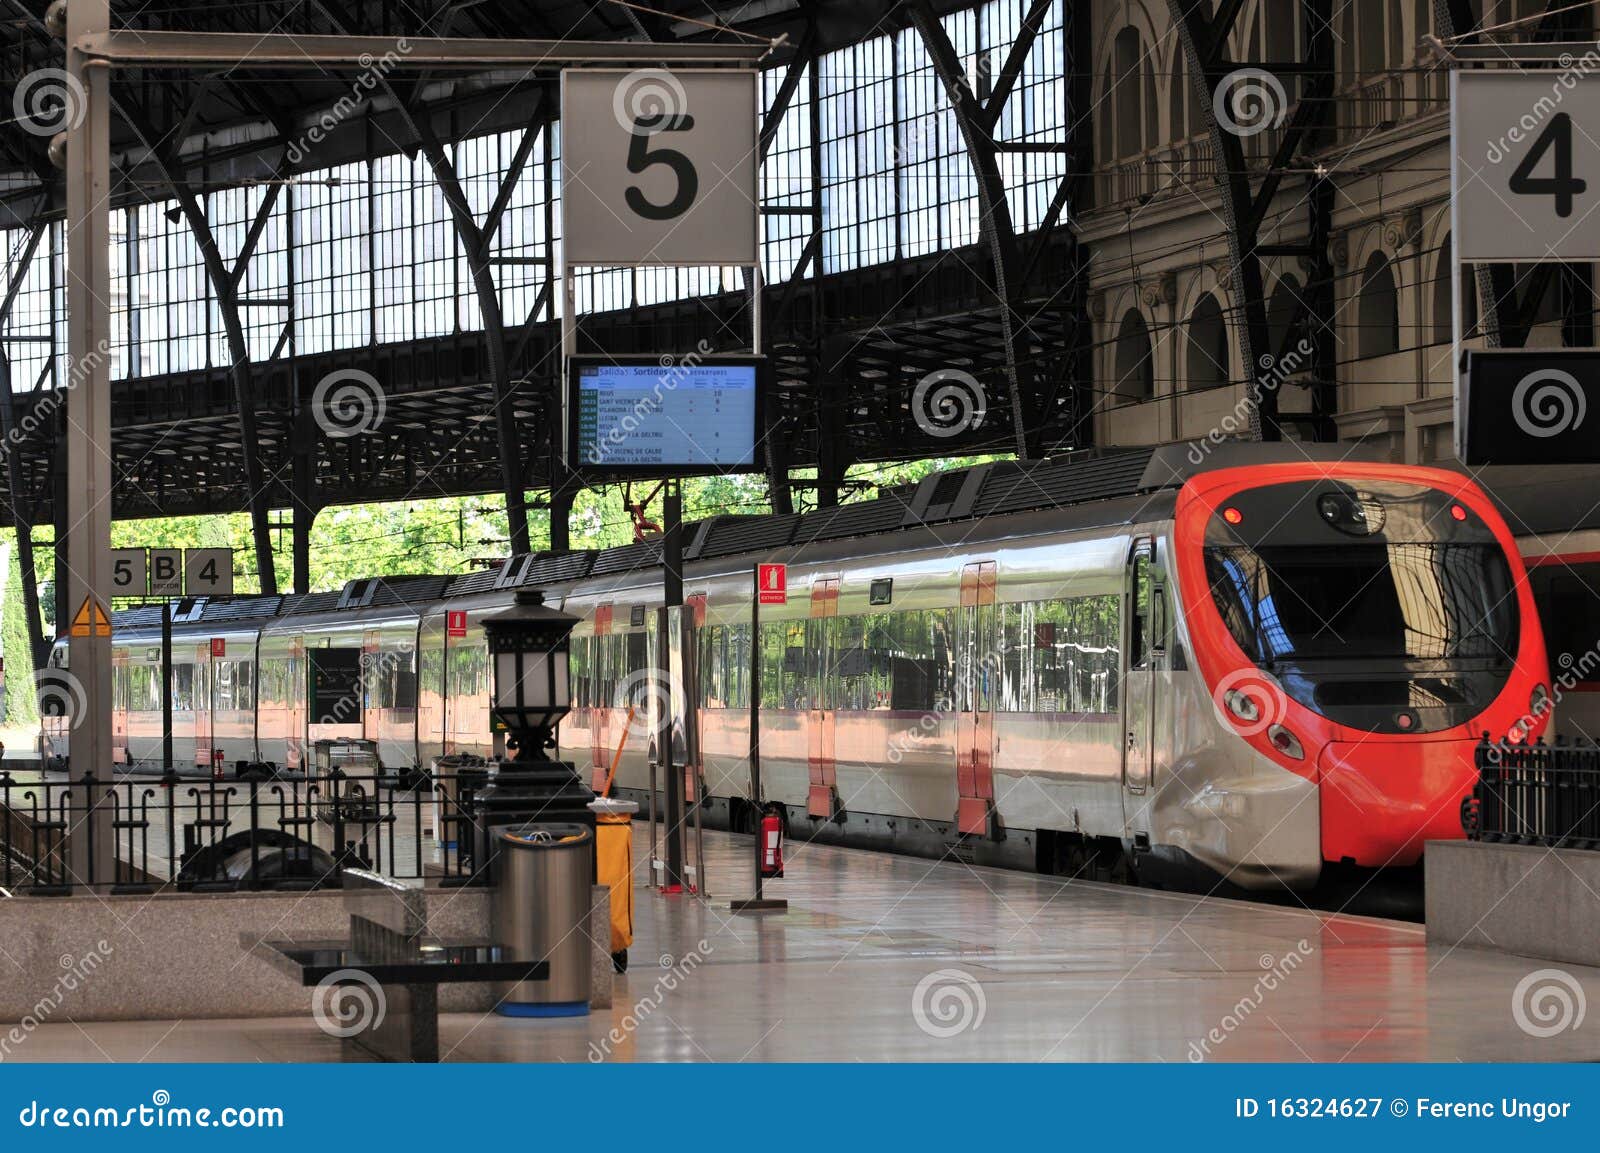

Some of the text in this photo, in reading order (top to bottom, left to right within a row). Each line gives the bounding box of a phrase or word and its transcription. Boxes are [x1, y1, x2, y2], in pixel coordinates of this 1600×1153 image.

[625, 114, 699, 220] 5
[1509, 112, 1587, 218] 4
[113, 559, 132, 585] 5
[156, 556, 176, 580] B
[199, 558, 219, 585] 4
